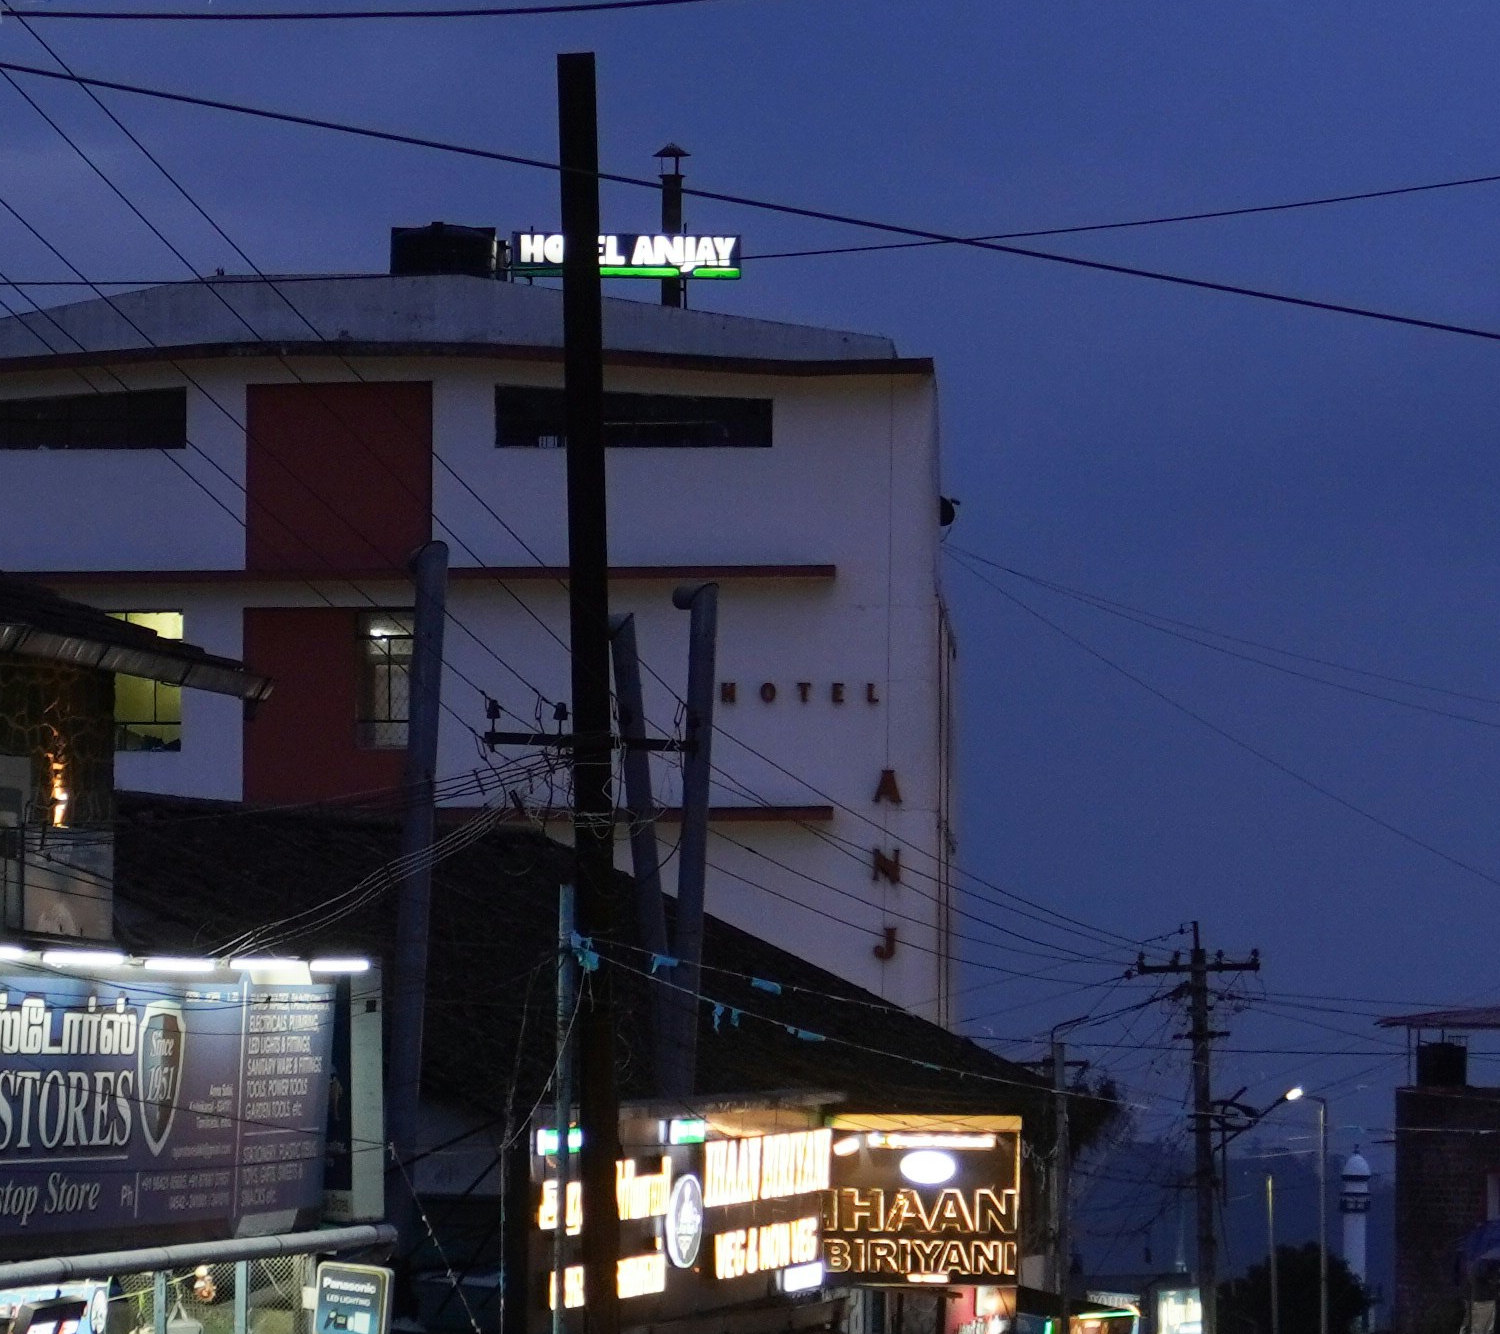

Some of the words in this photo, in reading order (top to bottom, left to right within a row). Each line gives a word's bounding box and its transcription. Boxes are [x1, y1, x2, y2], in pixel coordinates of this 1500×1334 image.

[520, 234, 624, 265] HOEL
[632, 235, 737, 272] ANJAY
[720, 681, 879, 704] HOTEL
[150, 1030, 175, 1058] Since
[247, 1057, 276, 1076] SANITARY
[146, 1064, 175, 1101] 1951
[245, 1103, 271, 1120] GARDEN
[44, 1171, 100, 1214] Store
[715, 1231, 746, 1279] VEG
[758, 1222, 790, 1272] NON
[789, 1215, 819, 1266] VEG
[823, 1238, 1017, 1276] BIRIYANI
[323, 1276, 376, 1294] Panasonic
[326, 1293, 340, 1303] LED
[340, 1295, 371, 1307] LIGHTING
